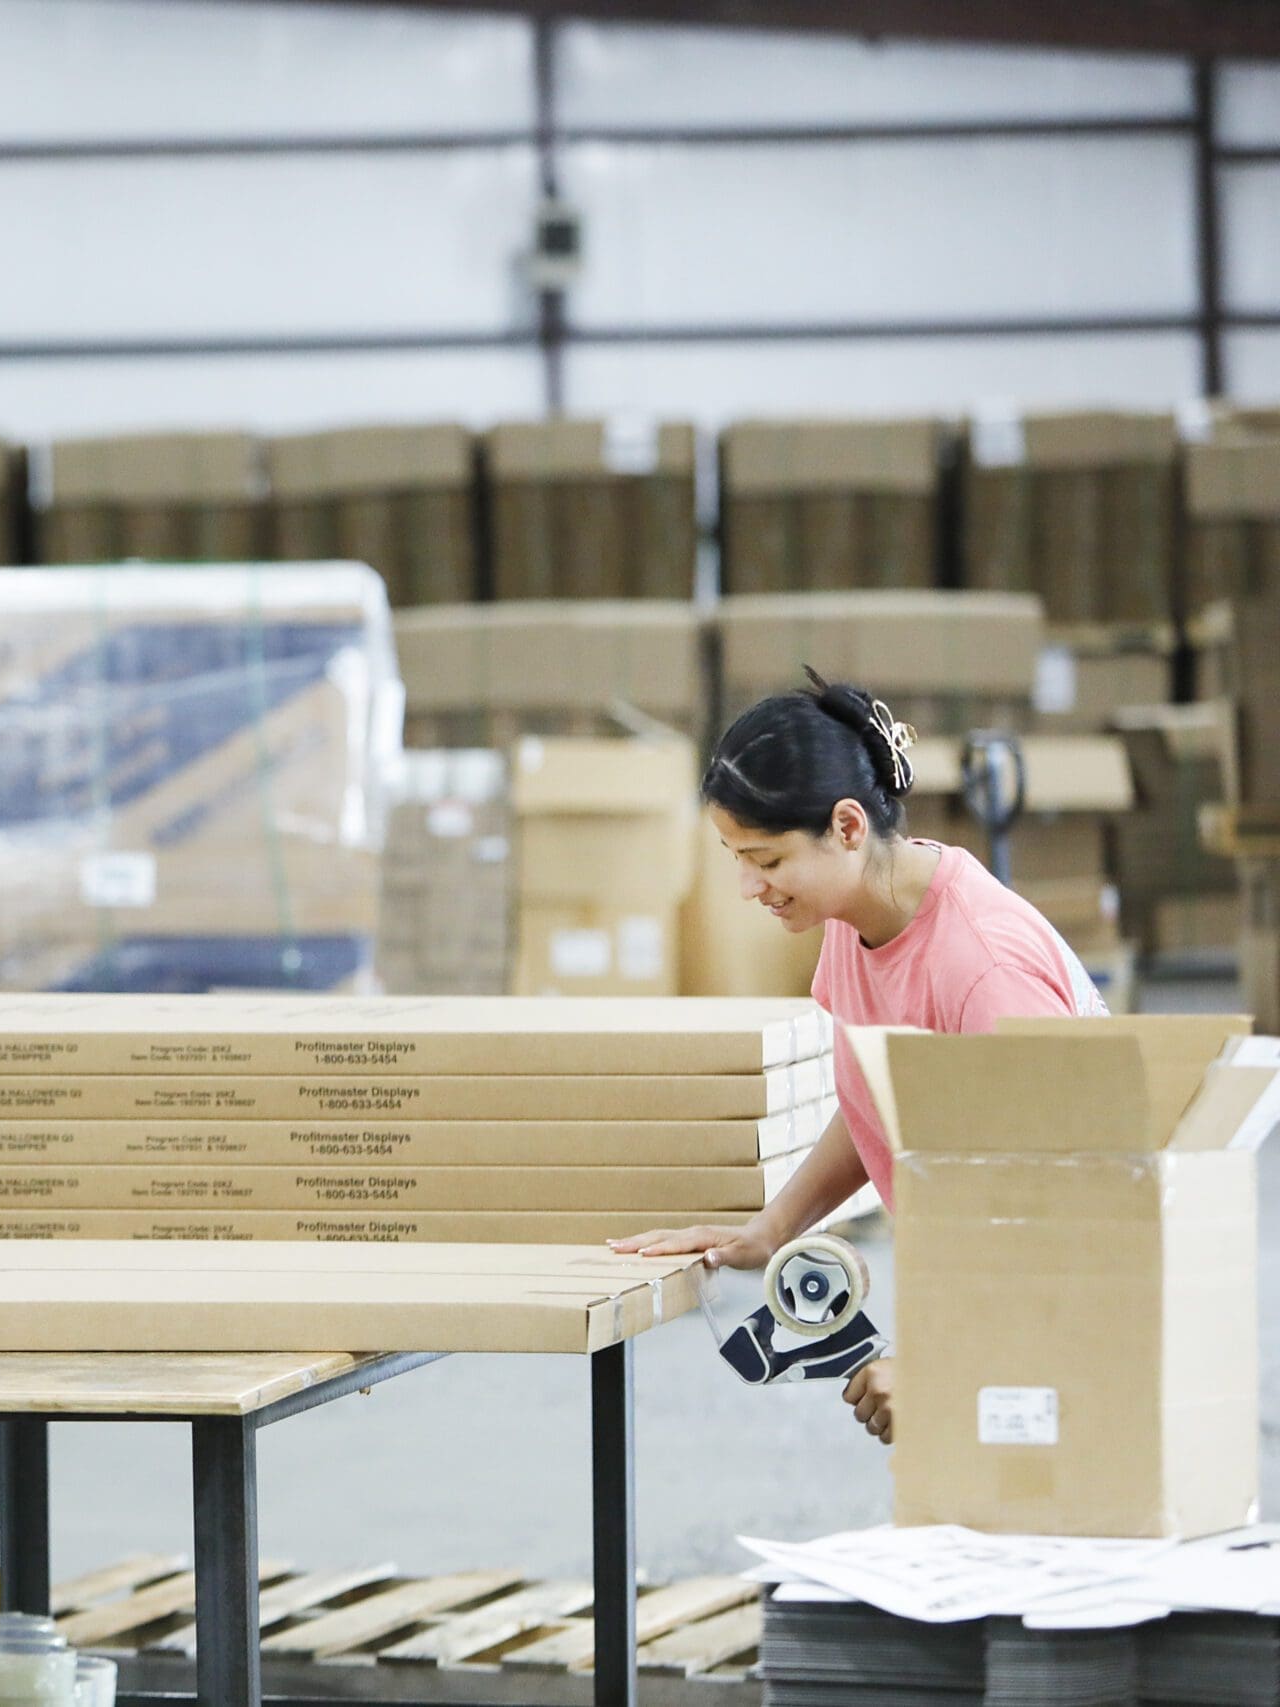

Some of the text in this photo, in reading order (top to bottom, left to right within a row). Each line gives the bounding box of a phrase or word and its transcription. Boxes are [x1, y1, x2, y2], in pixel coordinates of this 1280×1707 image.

[151, 1045, 184, 1055] Program
[295, 1041, 416, 1053] Profitmaster Displays
[315, 1054, 397, 1064] 1-800-633-5454
[155, 1090, 188, 1100] Program
[299, 1086, 420, 1098] Profitmaster Displays
[319, 1099, 401, 1108] 1-800-633-5454
[146, 1135, 179, 1145] Program
[290, 1132, 411, 1144] Profitmaster Displays
[310, 1144, 392, 1154] 1-800-633-5454
[152, 1180, 185, 1190] Program
[296, 1177, 417, 1189] Profitmaster Displays
[316, 1190, 398, 1199] 1-800-633-5454
[152, 1225, 185, 1235] Program
[296, 1221, 417, 1234] Profitmaster Displays
